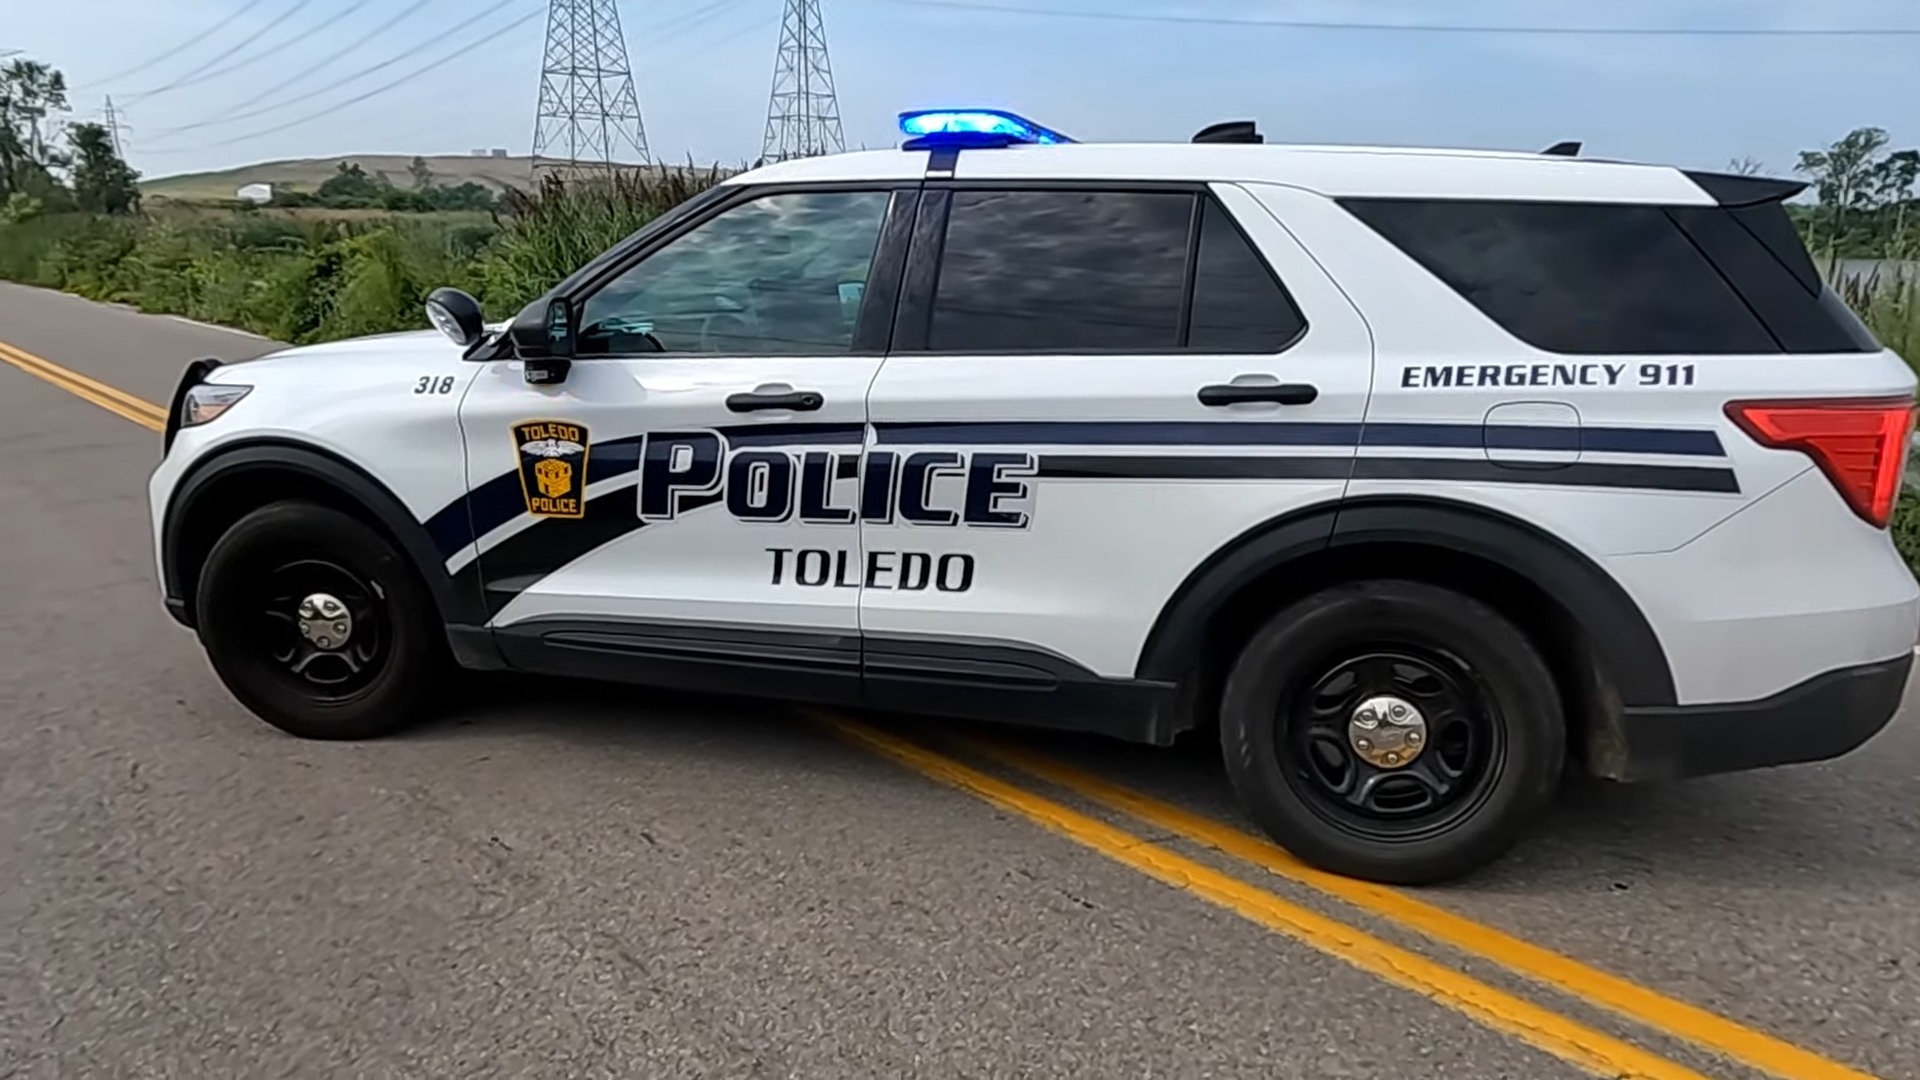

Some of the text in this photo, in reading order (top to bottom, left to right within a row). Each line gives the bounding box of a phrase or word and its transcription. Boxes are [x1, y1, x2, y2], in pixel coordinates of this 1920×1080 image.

[414, 375, 455, 394] 318
[1401, 364, 1695, 388] EMERGENCY 911
[521, 423, 579, 441] TOLEDO
[637, 430, 1036, 529] POLICE
[531, 497, 577, 513] POLICE
[765, 548, 974, 592] TOLEDO
